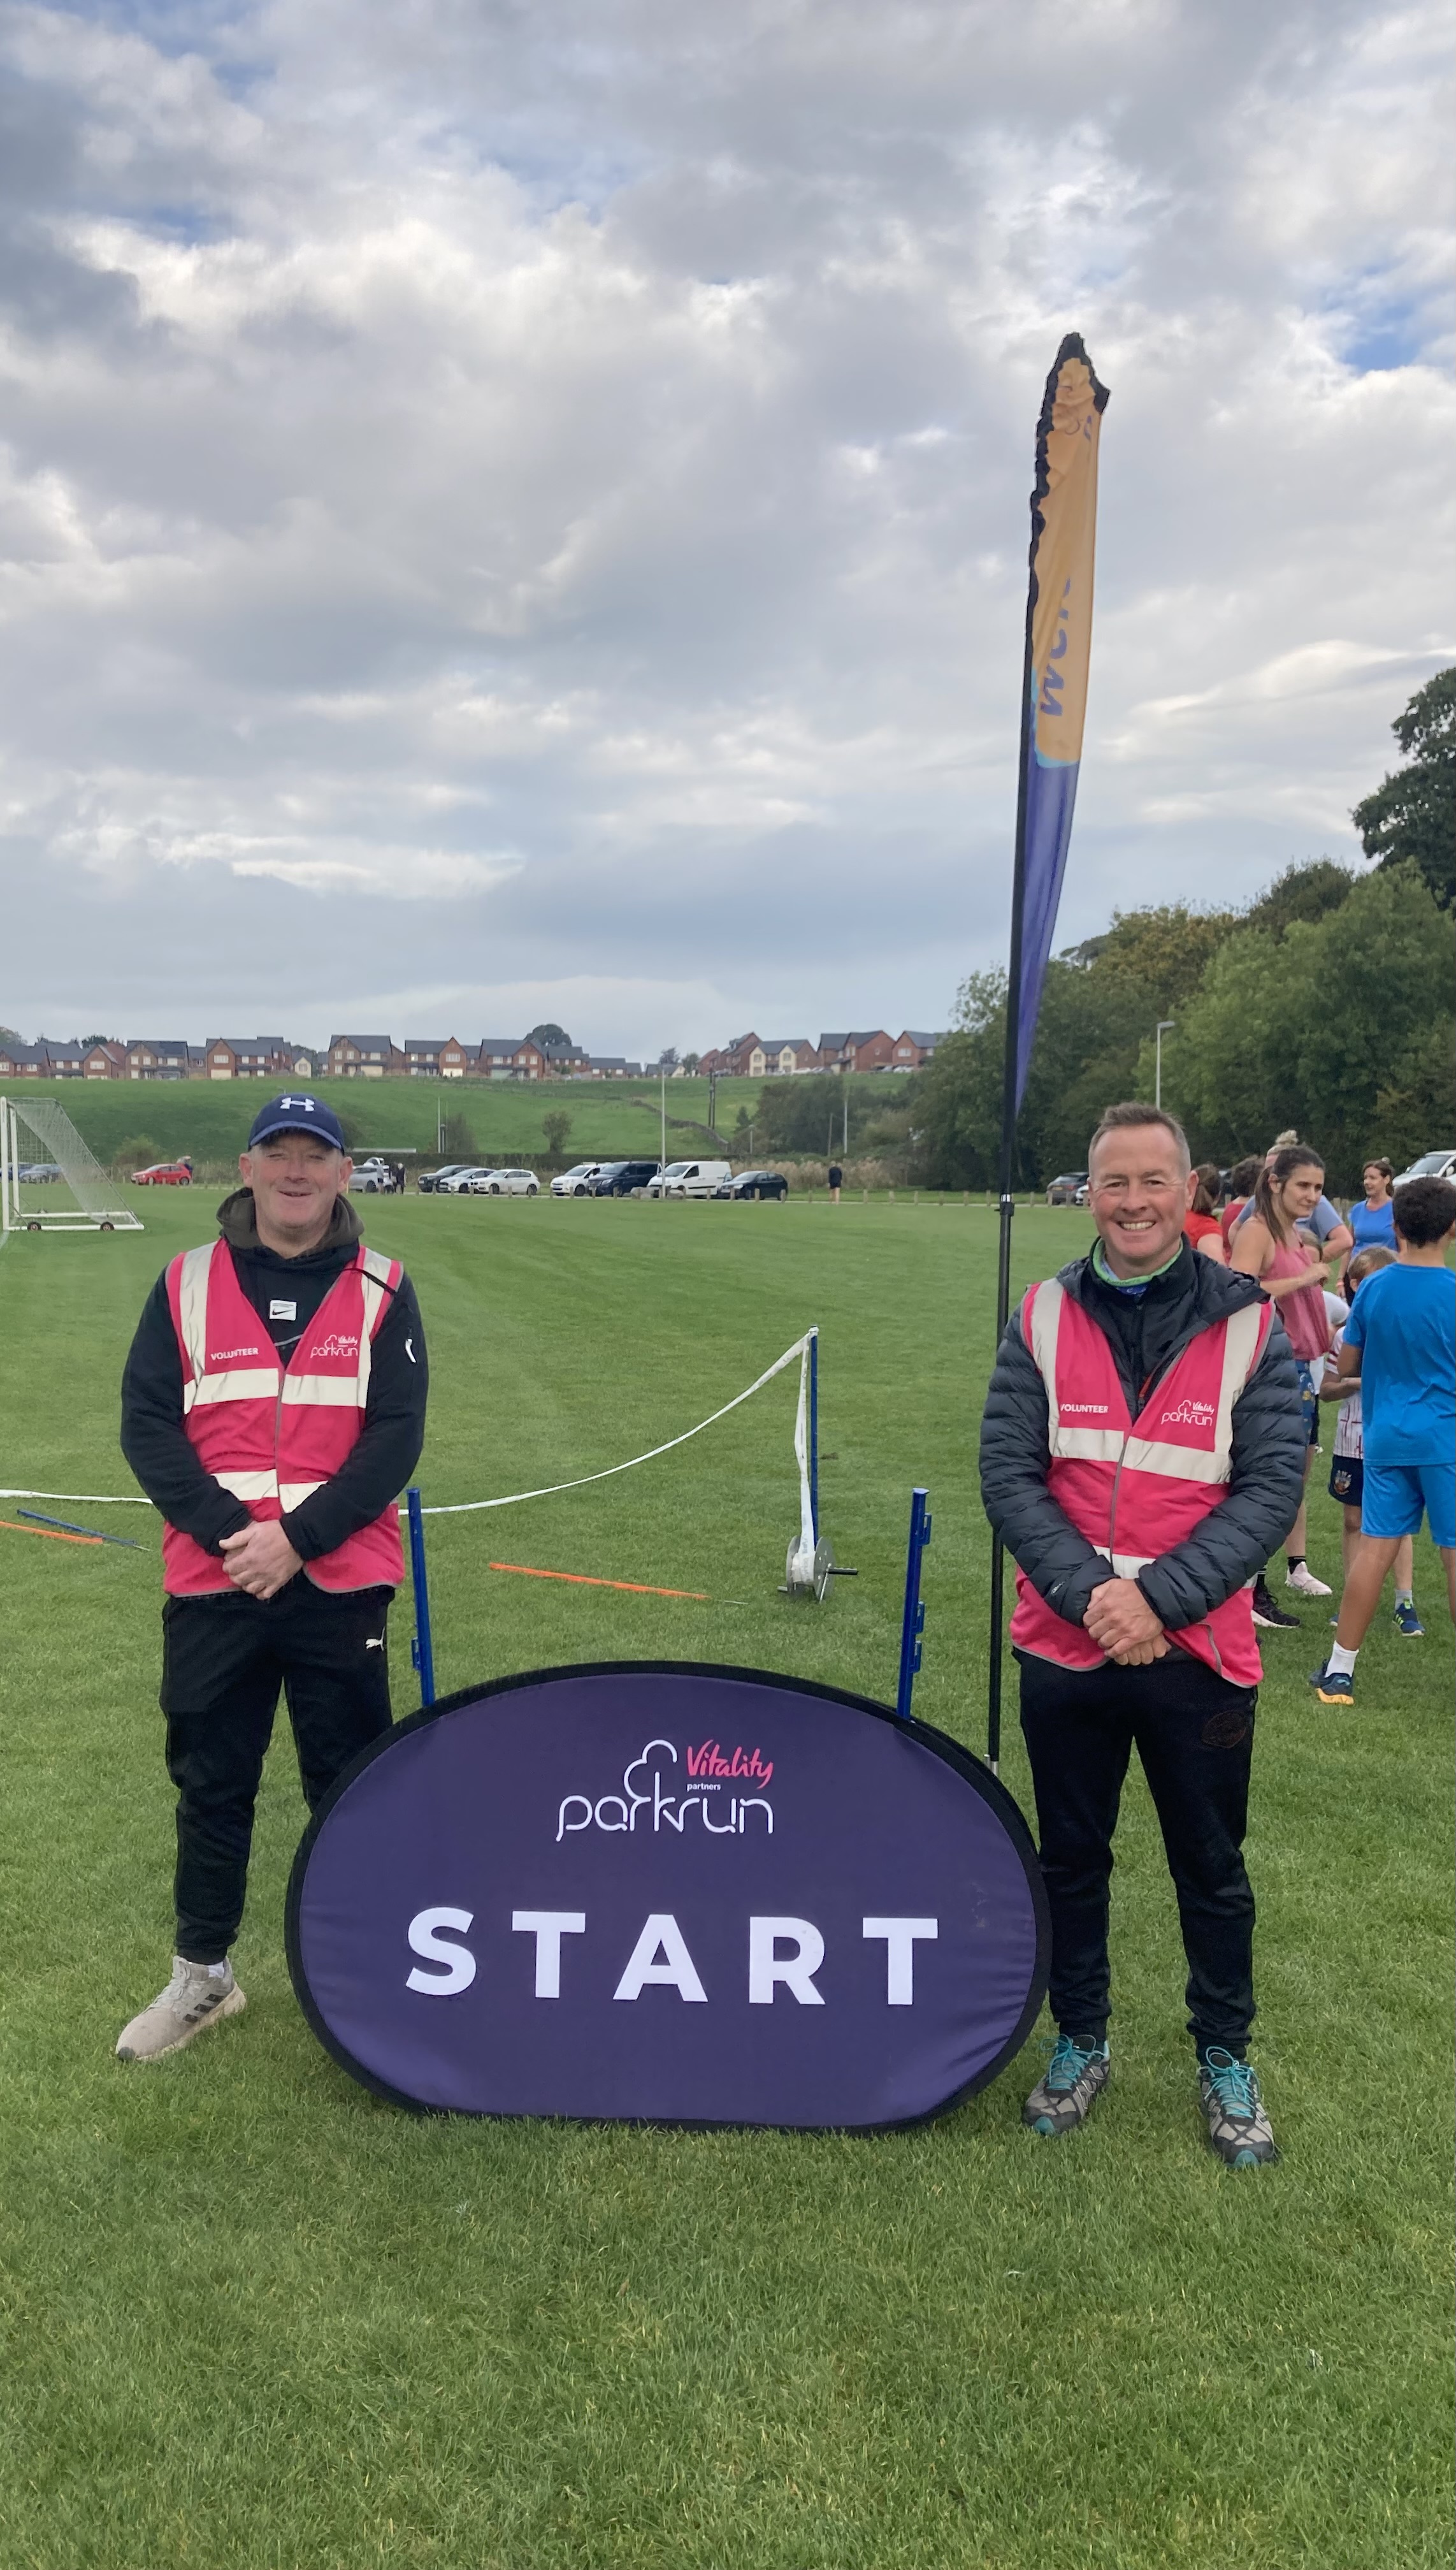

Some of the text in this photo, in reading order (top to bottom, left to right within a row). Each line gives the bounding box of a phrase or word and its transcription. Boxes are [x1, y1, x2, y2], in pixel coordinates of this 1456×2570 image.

[210, 1347, 259, 1361] VOLUNTEER
[310, 1342, 358, 1358] parkrun
[1160, 1407, 1213, 1427] parkrun
[687, 1739, 774, 1789] Vitality
[686, 1783, 721, 1792] partners
[556, 1771, 774, 1842] parkrun
[405, 1906, 938, 2005] START
